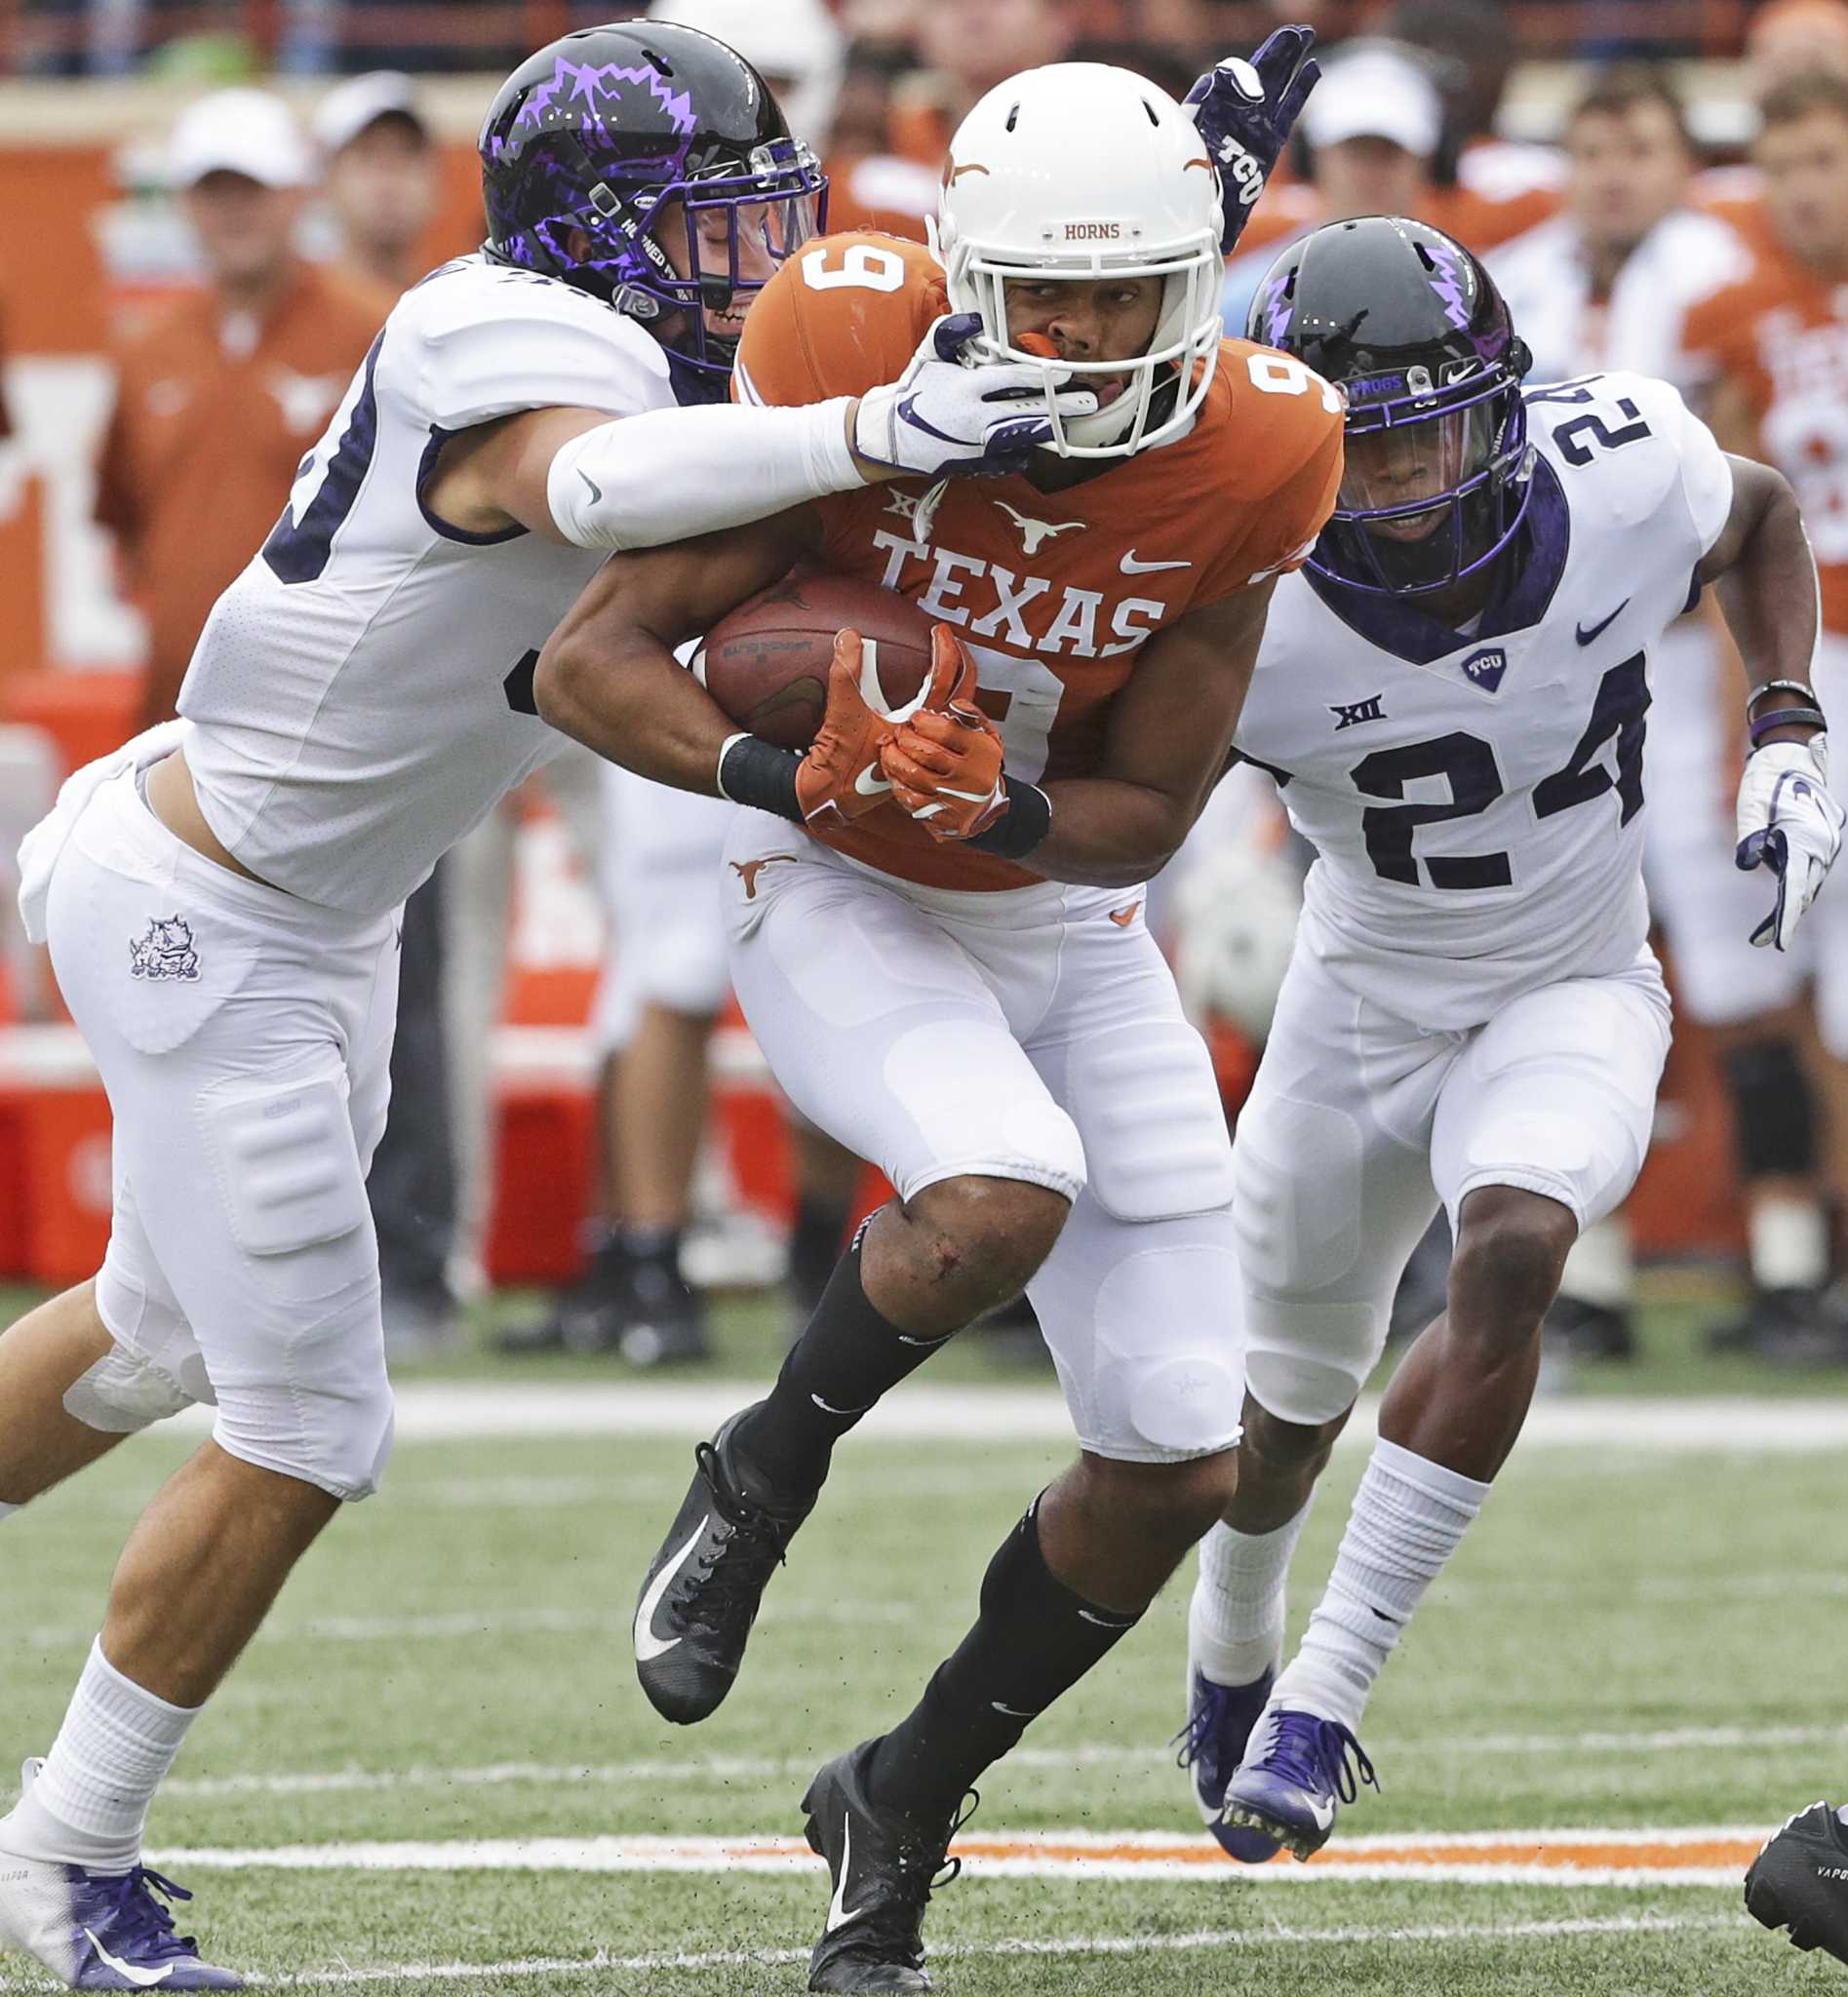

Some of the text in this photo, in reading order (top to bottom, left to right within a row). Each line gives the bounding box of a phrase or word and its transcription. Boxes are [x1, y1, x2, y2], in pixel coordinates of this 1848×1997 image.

[1218, 135, 1264, 205] TCU
[1065, 223, 1121, 241] HORNS
[1350, 374, 1403, 401] FROGS
[873, 529, 1165, 658] TEXAS
[1468, 654, 1503, 677] TCU
[1330, 694, 1387, 730] XII
[1350, 650, 1652, 888] 24
[1817, 1865, 1848, 1881] VAPO
